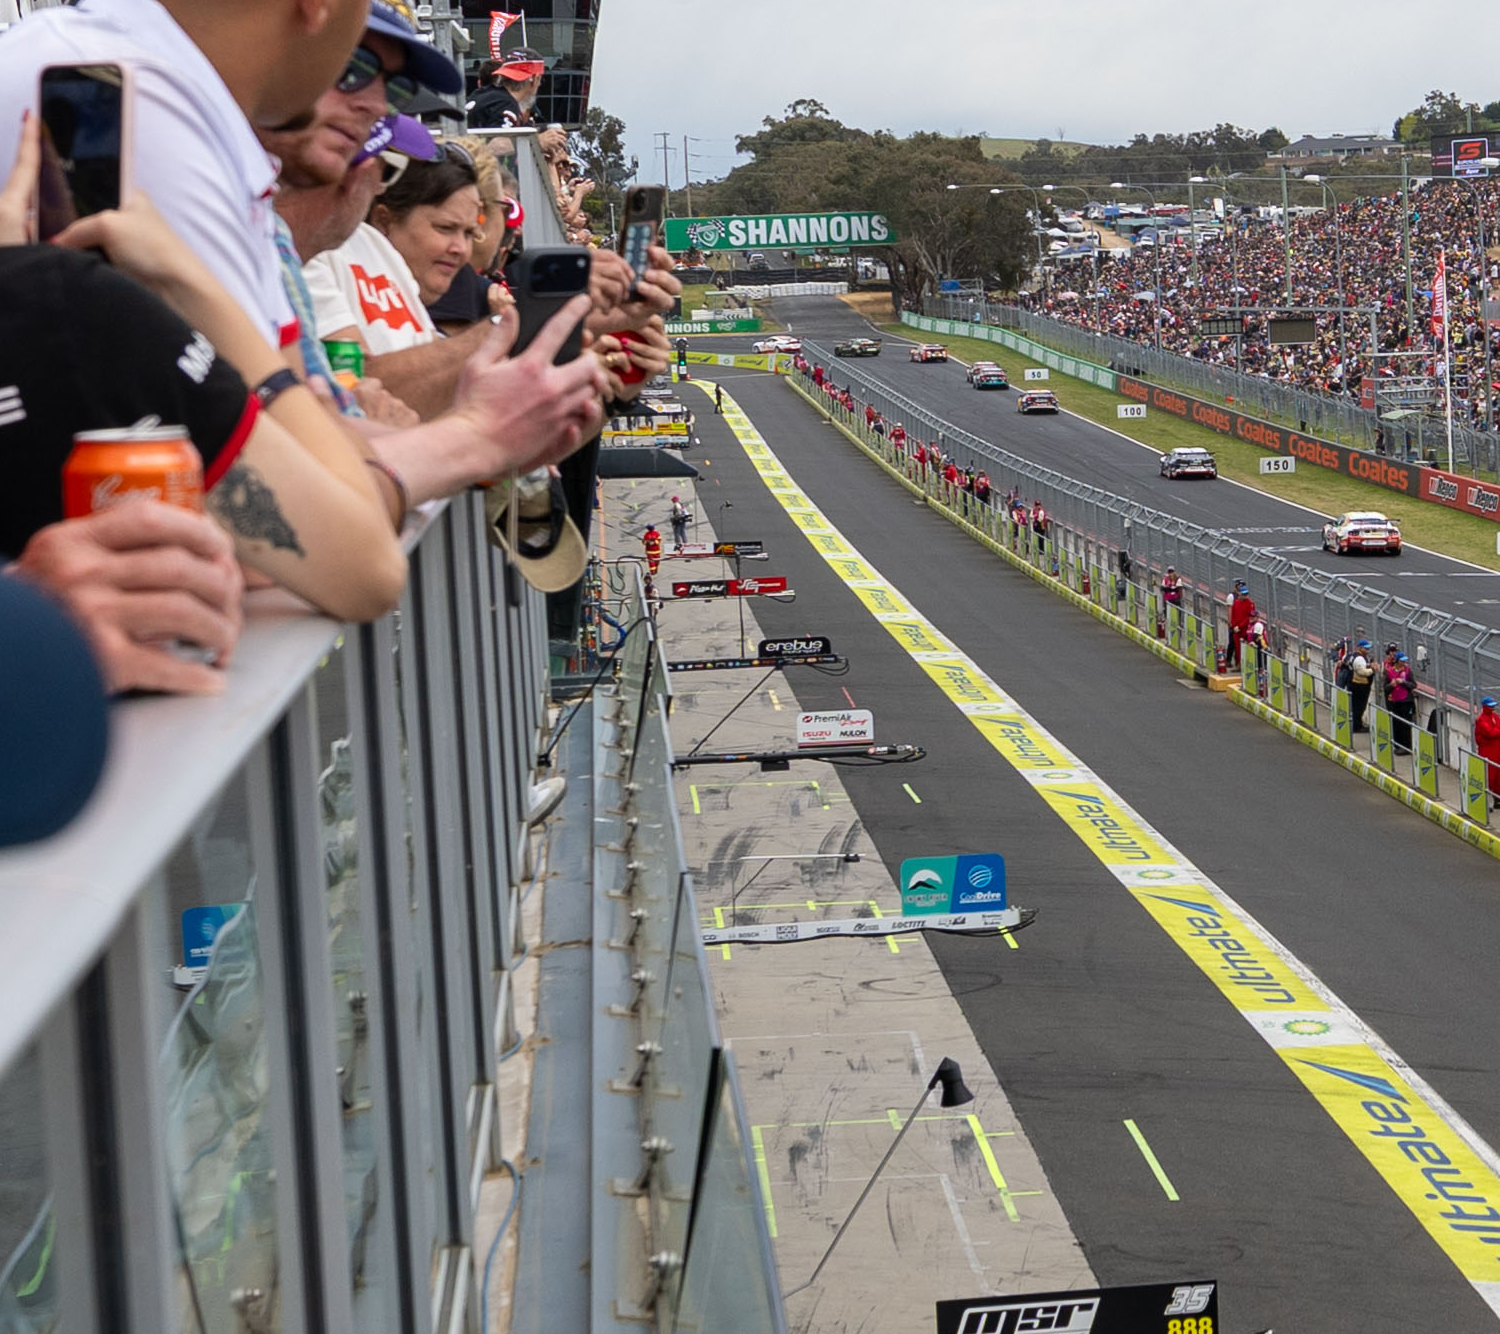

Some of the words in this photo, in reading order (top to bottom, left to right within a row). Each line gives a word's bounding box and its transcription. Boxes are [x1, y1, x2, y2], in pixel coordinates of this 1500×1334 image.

[728, 216, 889, 247] SHANNONS
[1031, 370, 1042, 379] 50
[1119, 377, 1149, 403] Coates
[1153, 388, 1187, 416] Coates
[1123, 407, 1142, 416] 100
[1192, 402, 1231, 432] Coates
[1236, 417, 1281, 450] Coates
[1288, 434, 1340, 469] Coates
[1266, 460, 1289, 471] 150
[1349, 452, 1409, 491] Coates
[1438, 475, 1458, 501] Repco
[1477, 486, 1500, 513] Repco
[765, 639, 823, 652] erebus
[944, 665, 989, 702] ultimate
[813, 714, 852, 723] PremiAir
[803, 730, 832, 738] ISUZU
[1001, 721, 1054, 769] ultimate
[1077, 803, 1151, 861] ultimate
[959, 891, 1001, 902] CoolDrive
[891, 919, 926, 929] LOCTITE
[1186, 916, 1296, 1004] ultimate
[1165, 1284, 1214, 1316] 35
